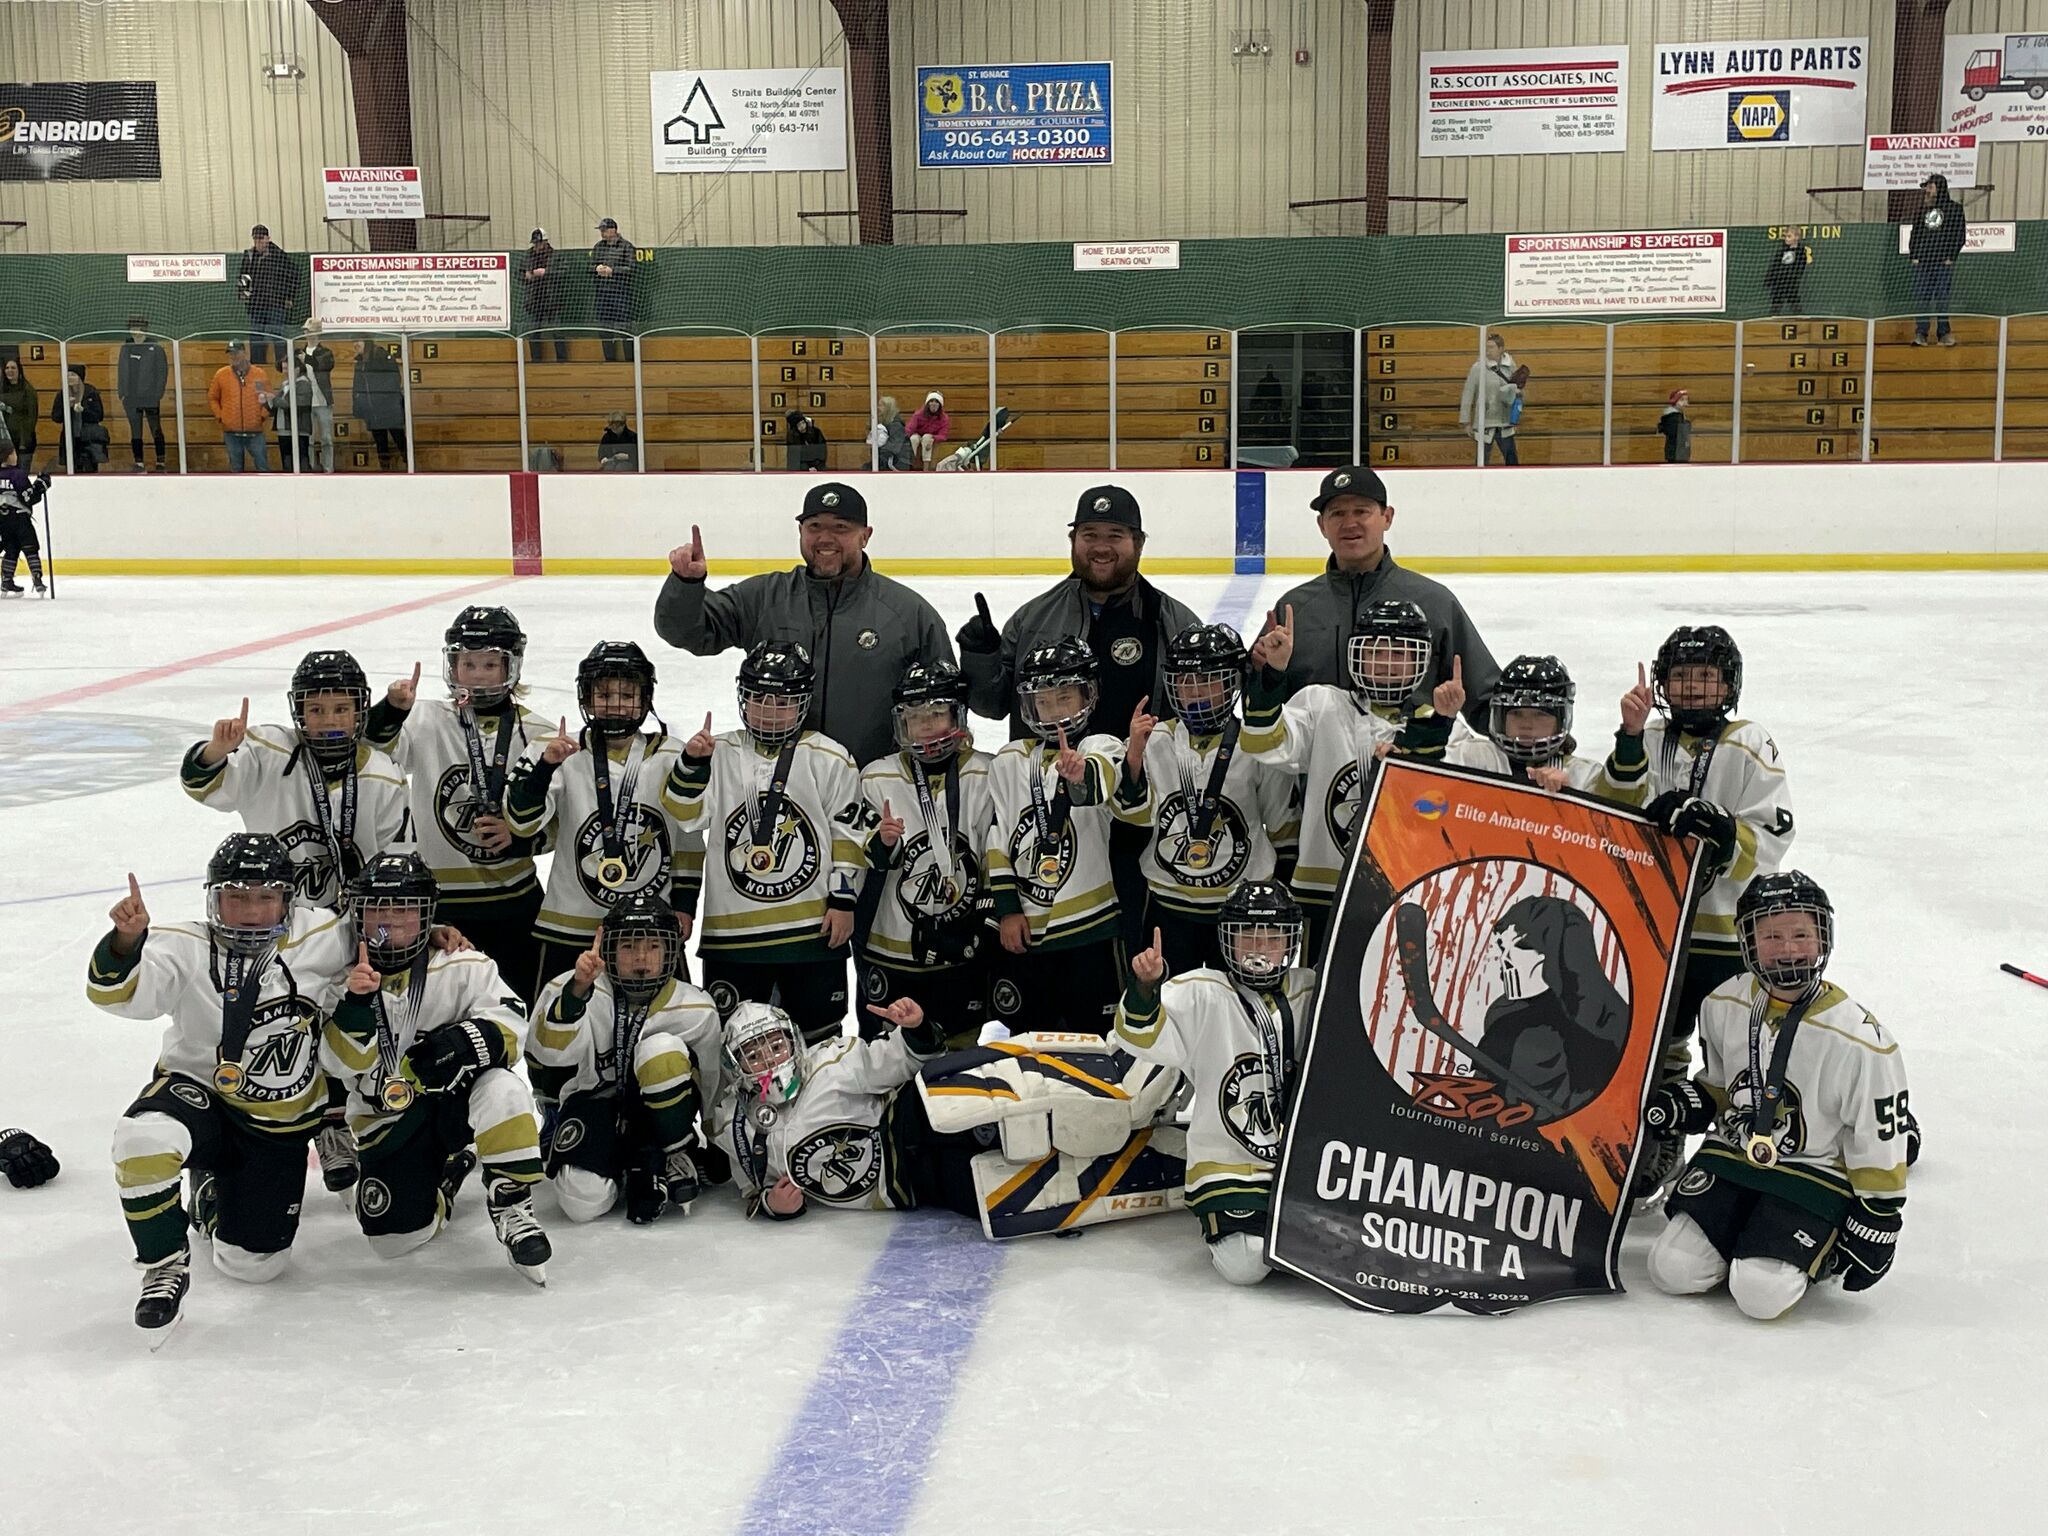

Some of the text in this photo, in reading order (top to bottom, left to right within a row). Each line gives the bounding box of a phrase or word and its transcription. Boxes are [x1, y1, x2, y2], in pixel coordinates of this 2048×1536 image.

[1660, 46, 1861, 75] LYNN AUTO PARTS
[968, 70, 1010, 79] ST. IGNACE
[1456, 75, 1498, 88] SCOTT
[1503, 72, 1586, 87] ASSOCIATES,
[1589, 72, 1617, 84] INC.
[766, 88, 802, 97] Building
[805, 87, 837, 95] Center
[969, 81, 1104, 113] B.C. PIZZA
[1431, 95, 1616, 109] ENGINEERING ARCHITECTURE SURVEYING
[1741, 106, 1776, 126] NAPA
[1952, 105, 1976, 122] OPEN
[752, 123, 819, 133] (906) 643-7141
[937, 120, 992, 128] HOMETOWN
[1040, 117, 1086, 126] GOURMET
[14, 120, 137, 142] ENBRIDGE
[944, 129, 1090, 147] 906-643-0300
[1886, 136, 1960, 149] WARNING
[687, 147, 727, 157] Building
[928, 147, 1107, 161] Ask About Our HOCKEY SPECIALS
[339, 170, 405, 182] WARNING
[1768, 225, 1841, 240] SETION
[1965, 227, 2005, 238] PECTATOR
[1518, 234, 1714, 251] SPORTSMANSHIP IS EXPECTED
[1082, 246, 1170, 256] HOME TEAM SPECTATOR
[182, 258, 221, 267] SPECTATOR
[322, 257, 498, 270] SPORTSMANSHIP IS EXPECTED
[1100, 257, 1152, 266] SEATING ONLY
[153, 269, 201, 277] SEATING ONLY
[1532, 298, 1580, 306] OFFENDERS
[1604, 297, 1626, 305] HAVE
[1641, 296, 1668, 304] LEAVE
[1687, 295, 1717, 303] ARENA
[336, 316, 380, 324] OFFENDERS
[473, 608, 489, 619] 17
[1190, 632, 1199, 643] 6
[1455, 803, 1656, 867] Elite Amateur Sports Presents
[380, 856, 403, 867] 22
[229, 956, 241, 987] Sports
[1035, 1033, 1099, 1044] CCM
[1440, 1055, 1470, 1076] the
[1390, 1102, 1540, 1152] tournament series
[860, 1129, 881, 1189] NORTHS
[1111, 1196, 1163, 1211] CCM
[1316, 1140, 1583, 1259] CHAMPION
[1361, 1211, 1526, 1281] SQUIRT A
[1355, 1271, 1430, 1297] OCTOBER
